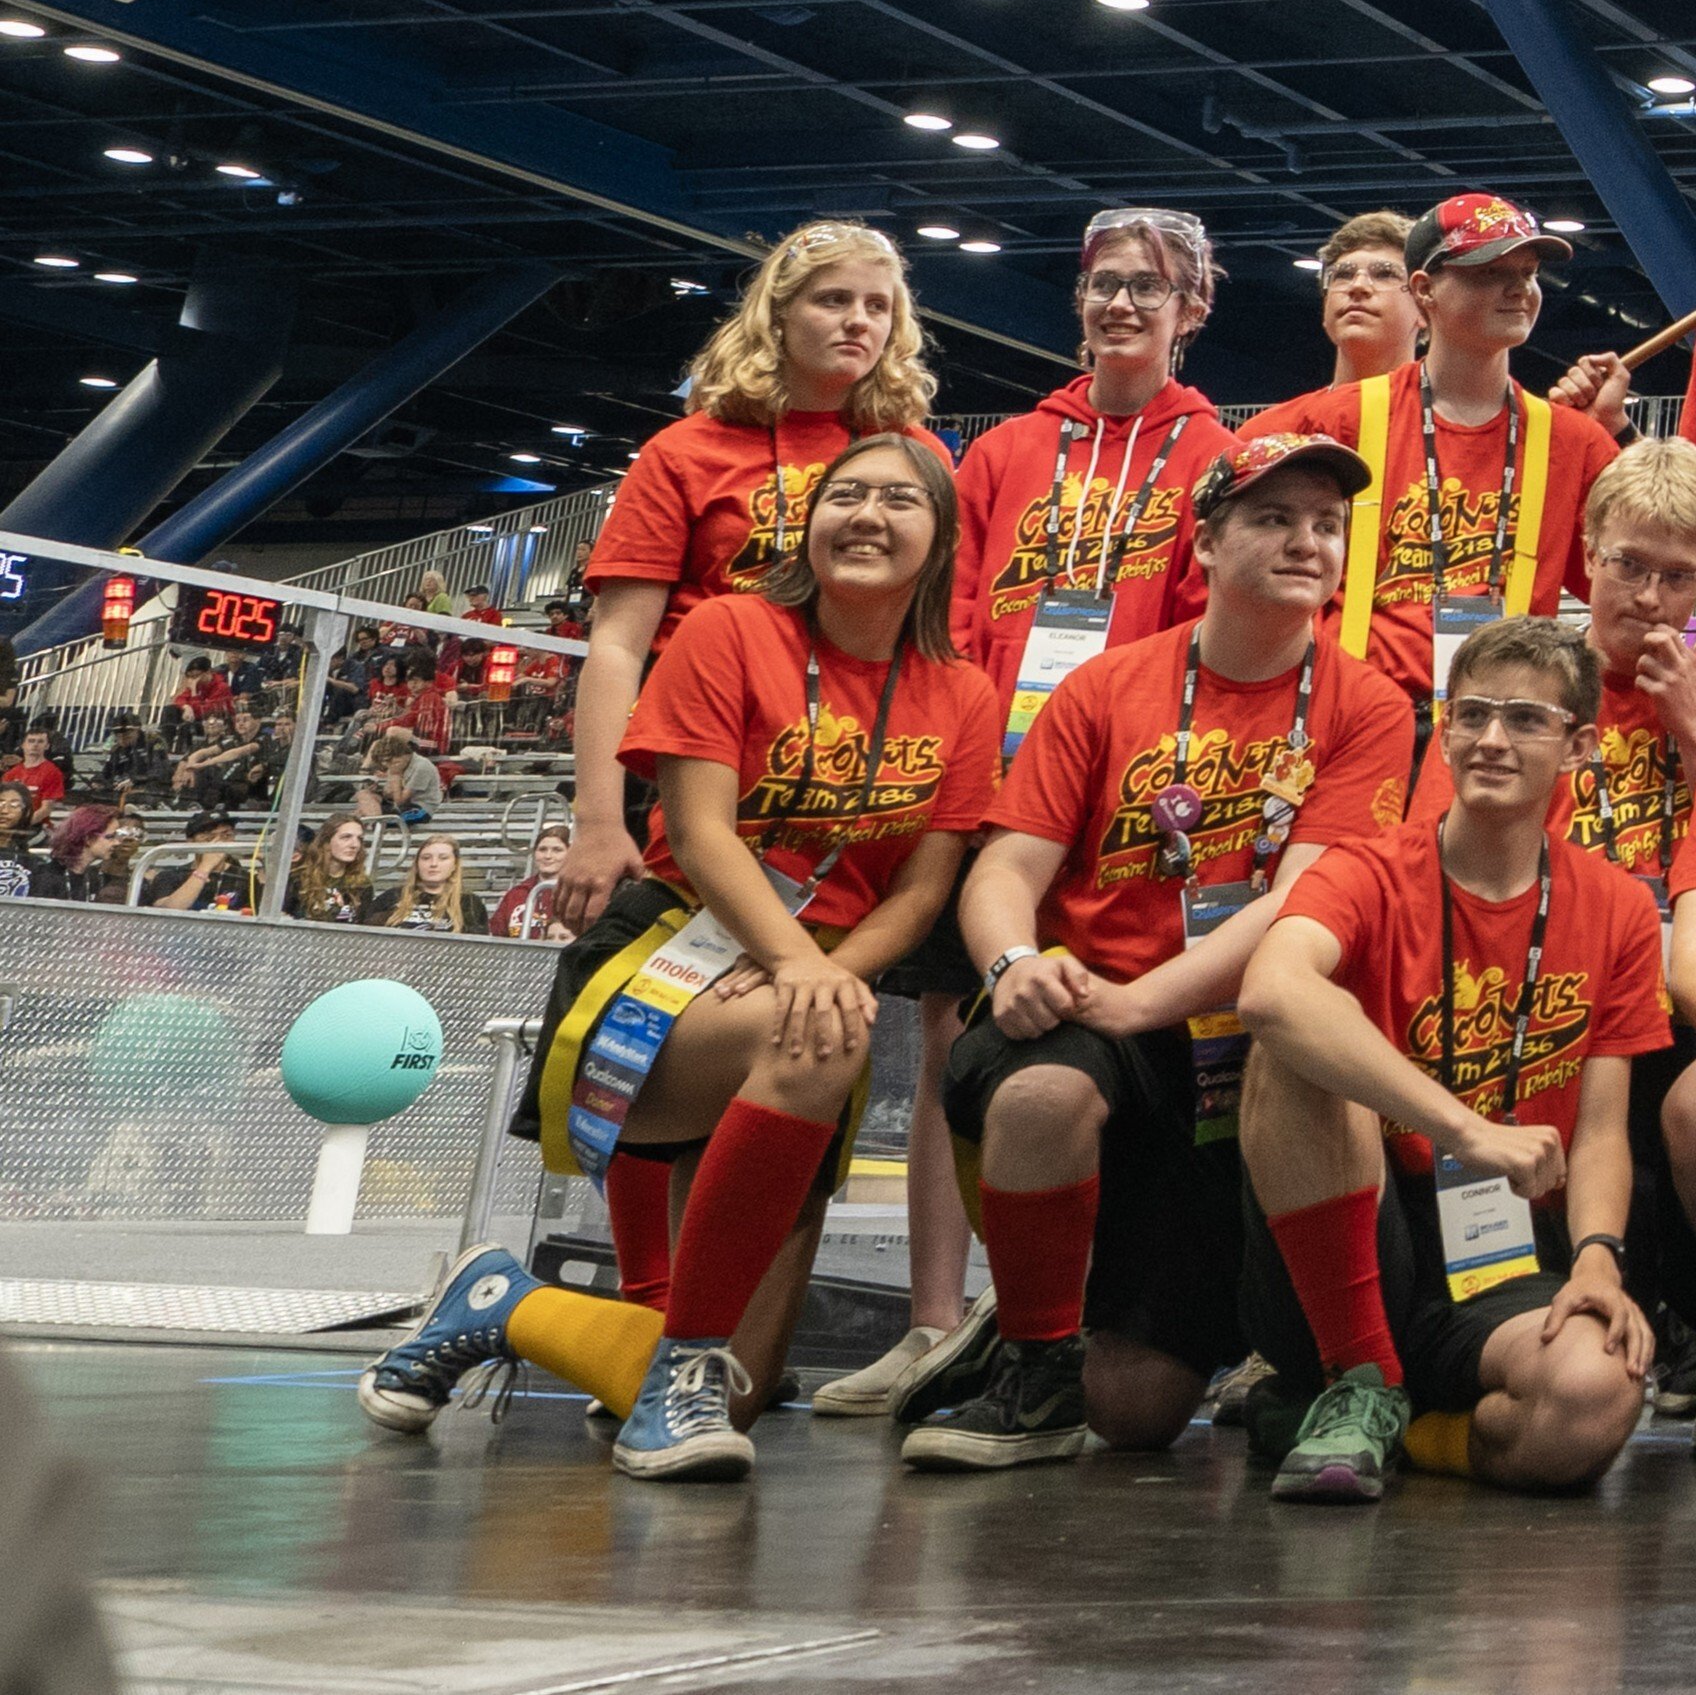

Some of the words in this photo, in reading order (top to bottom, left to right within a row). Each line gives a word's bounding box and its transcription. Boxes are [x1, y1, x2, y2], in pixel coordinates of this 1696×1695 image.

[198, 591, 276, 642] 2025
[650, 956, 711, 989] molex
[391, 1054, 436, 1070] FIRST
[1461, 1183, 1502, 1200] CONNOR
